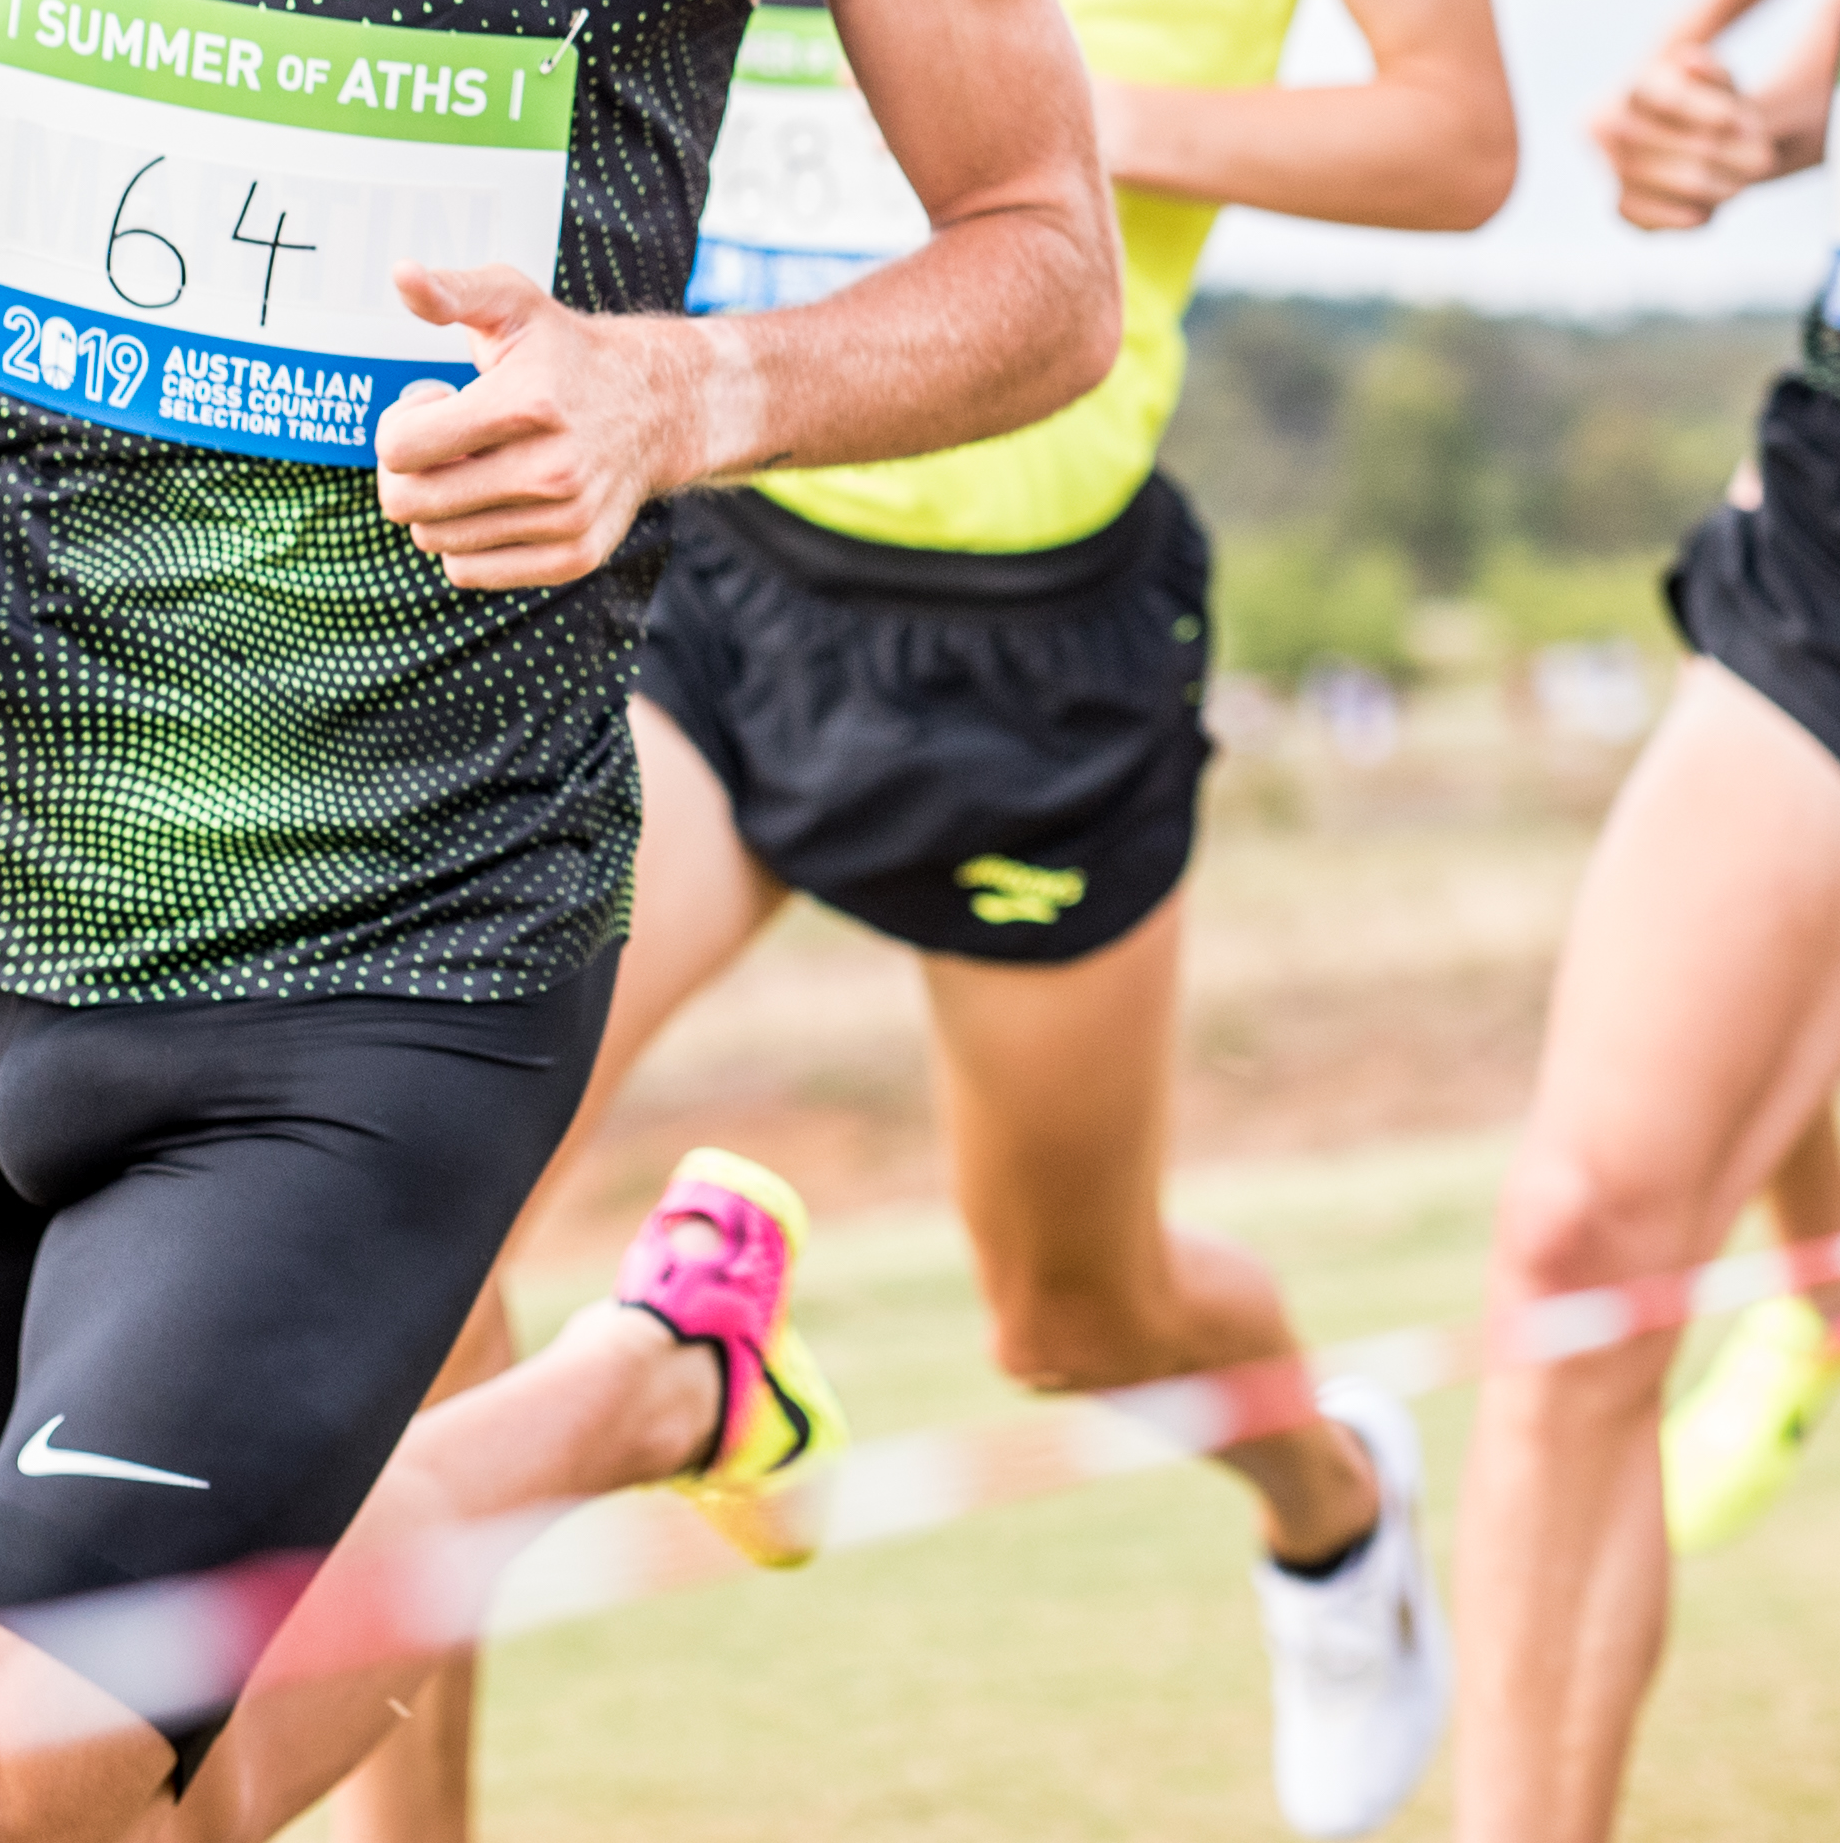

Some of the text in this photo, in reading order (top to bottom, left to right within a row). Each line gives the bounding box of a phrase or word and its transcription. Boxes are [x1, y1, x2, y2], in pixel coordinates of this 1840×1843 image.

[277, 55, 331, 95] OF
[337, 58, 488, 117] ATHS
[107, 155, 317, 326] 64
[2, 305, 150, 409] 2019
[163, 346, 373, 401] AUSTRALIAN
[160, 397, 367, 447] SELECTION TRIALS
[161, 375, 370, 425] CROSS COUNTRY
